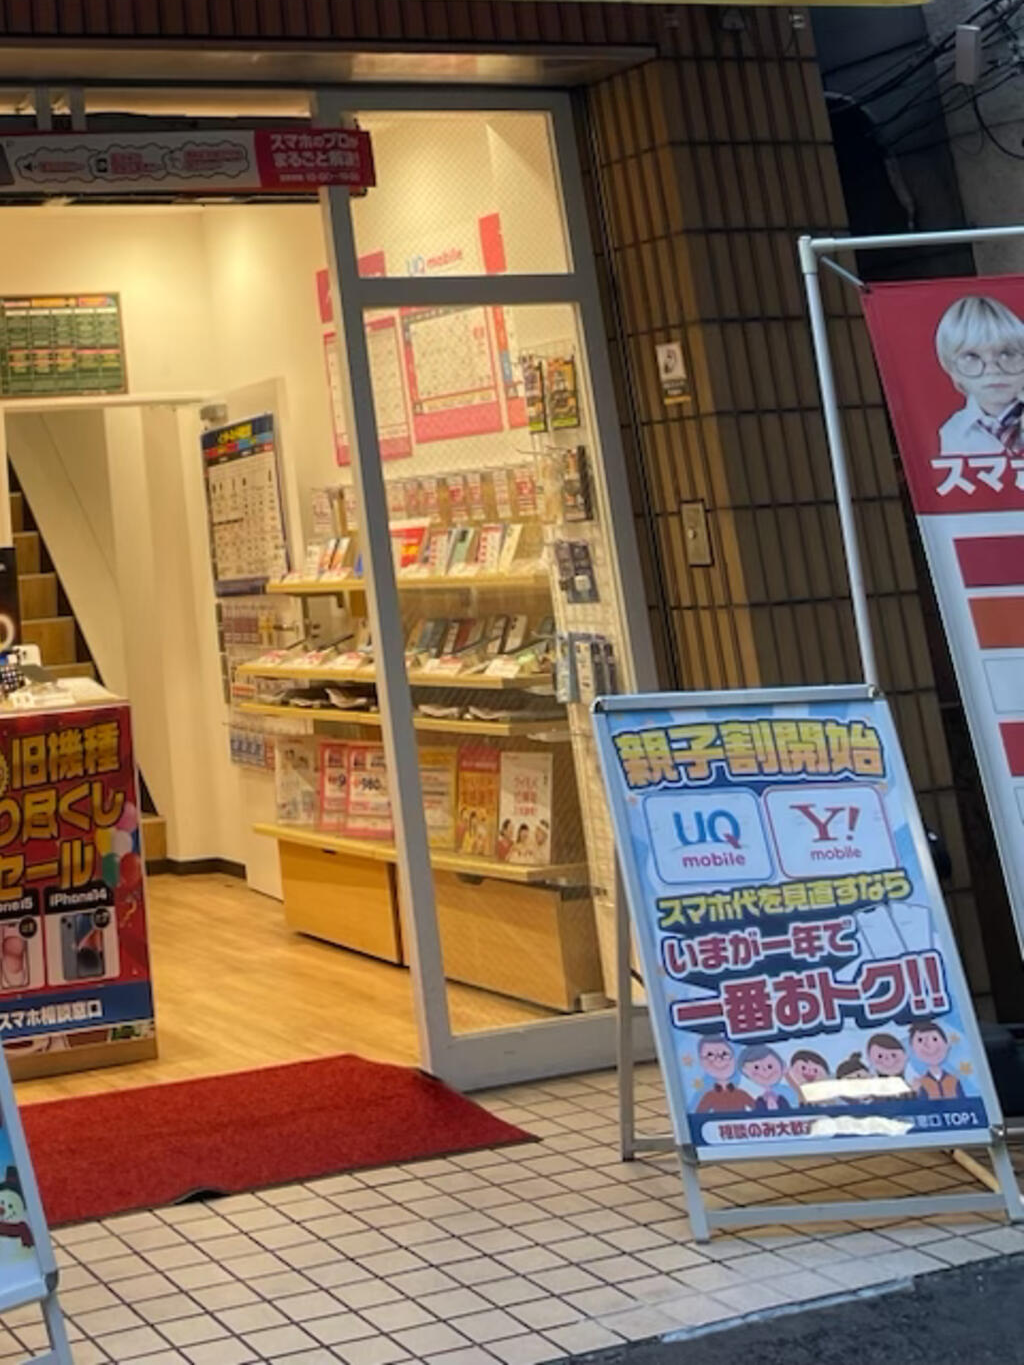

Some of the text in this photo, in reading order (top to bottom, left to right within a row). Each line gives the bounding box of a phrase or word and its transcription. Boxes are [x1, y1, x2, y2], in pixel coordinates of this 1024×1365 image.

[12, 722, 120, 784] 旧機種
[616, 720, 885, 788] 親子割開始
[674, 810, 743, 849] UQ
[790, 805, 860, 843] Y!
[683, 852, 746, 868] mobile
[810, 847, 862, 860] mobile
[659, 871, 912, 926] スマホ代を見直すなら
[665, 920, 855, 973] いまが一年で
[676, 955, 946, 1034] 一番おトク!!
[719, 1119, 812, 1140] 相談のみ大歓
